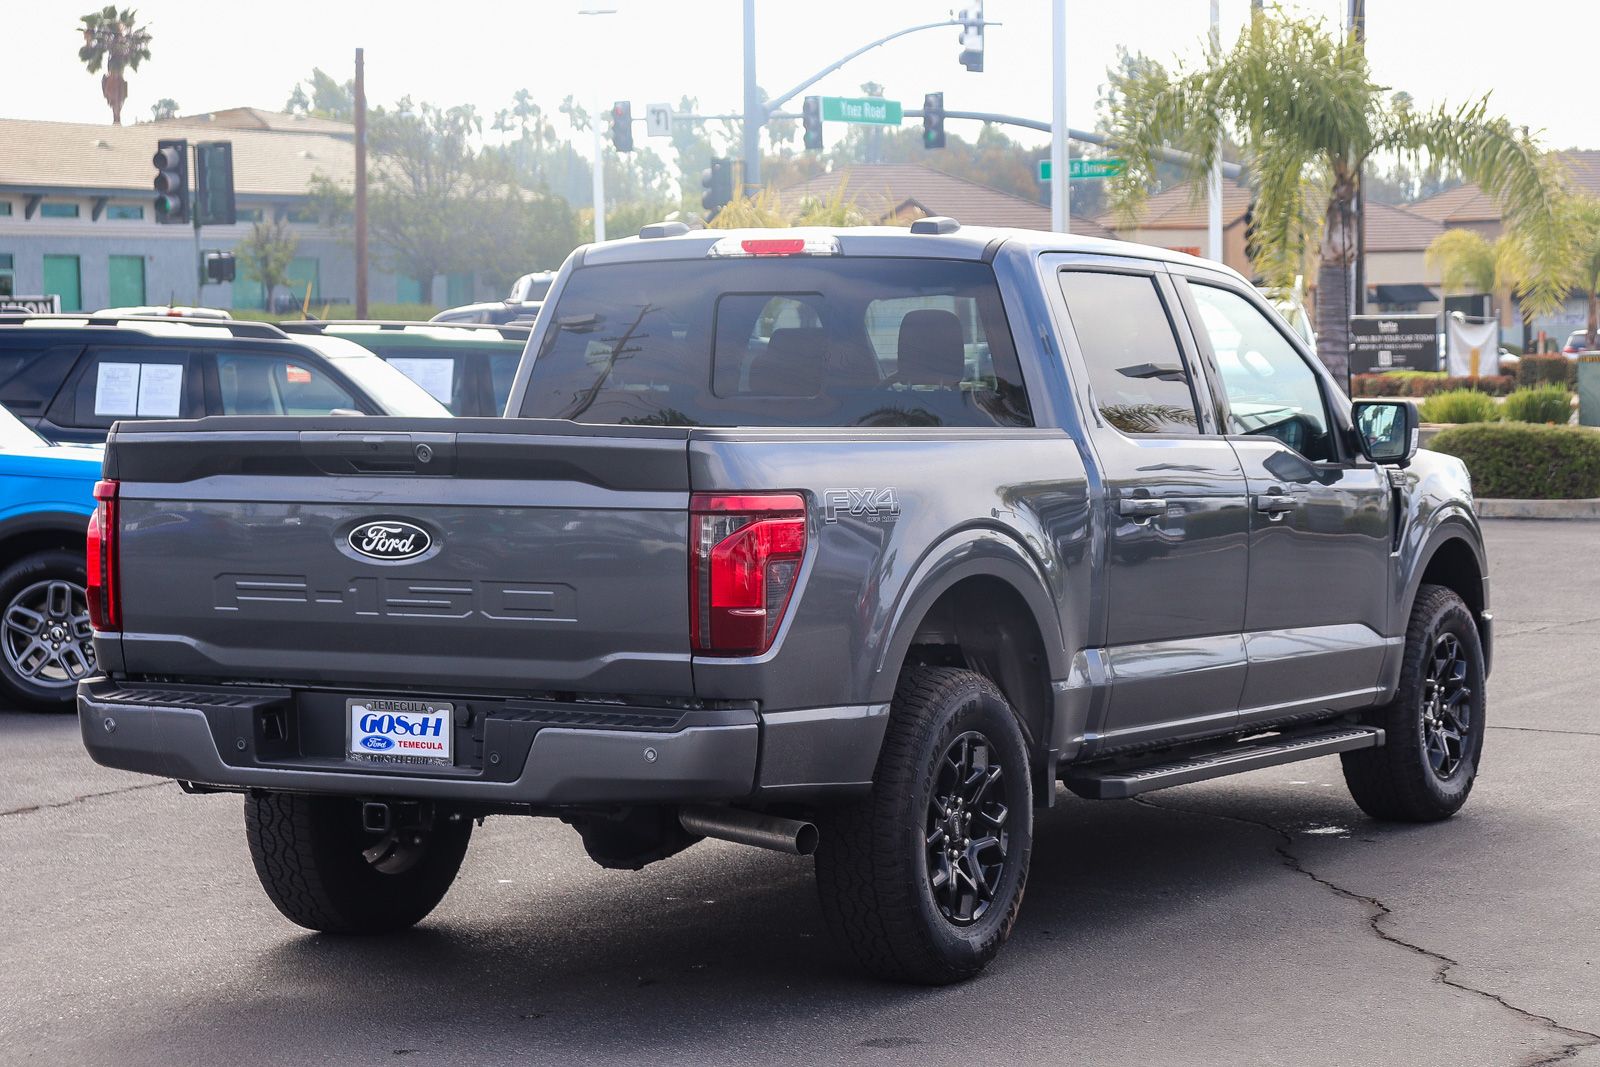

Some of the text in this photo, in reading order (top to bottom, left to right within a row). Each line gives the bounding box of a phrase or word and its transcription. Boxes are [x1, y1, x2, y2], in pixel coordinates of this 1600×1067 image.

[841, 101, 886, 120] Ynez Road
[824, 487, 900, 524] FX4
[362, 525, 415, 553] Ford
[213, 572, 578, 622] F-150
[372, 701, 428, 712] TEMECULA
[367, 738, 387, 748] Ford
[398, 740, 443, 750] TEMECULA
